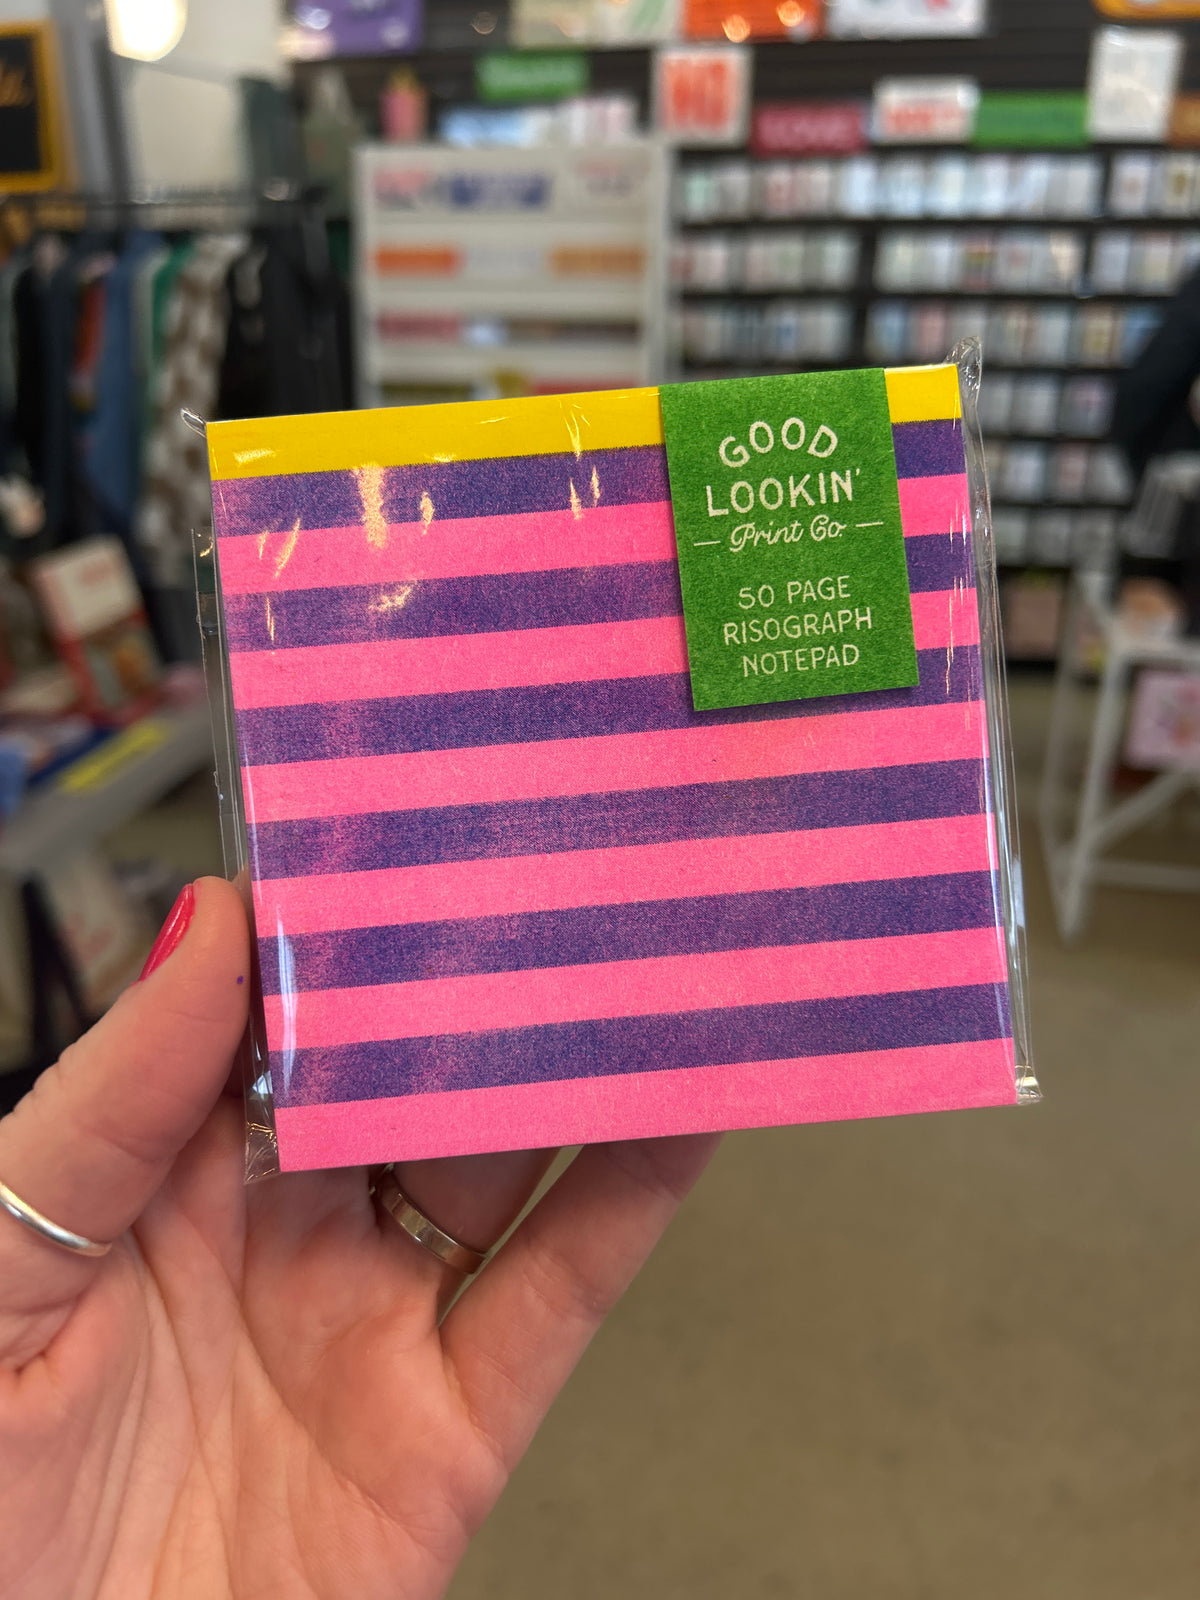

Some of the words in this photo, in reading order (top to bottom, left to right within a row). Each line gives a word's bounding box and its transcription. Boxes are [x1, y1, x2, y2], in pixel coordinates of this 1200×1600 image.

[718, 417, 838, 468] GOOD
[705, 468, 860, 517] LOOKIN'
[729, 522, 804, 552] Print
[738, 584, 775, 610] 50
[787, 575, 851, 604] PAGE
[723, 607, 872, 646] RISOGRAPH
[743, 644, 859, 677] NOTEPAD
